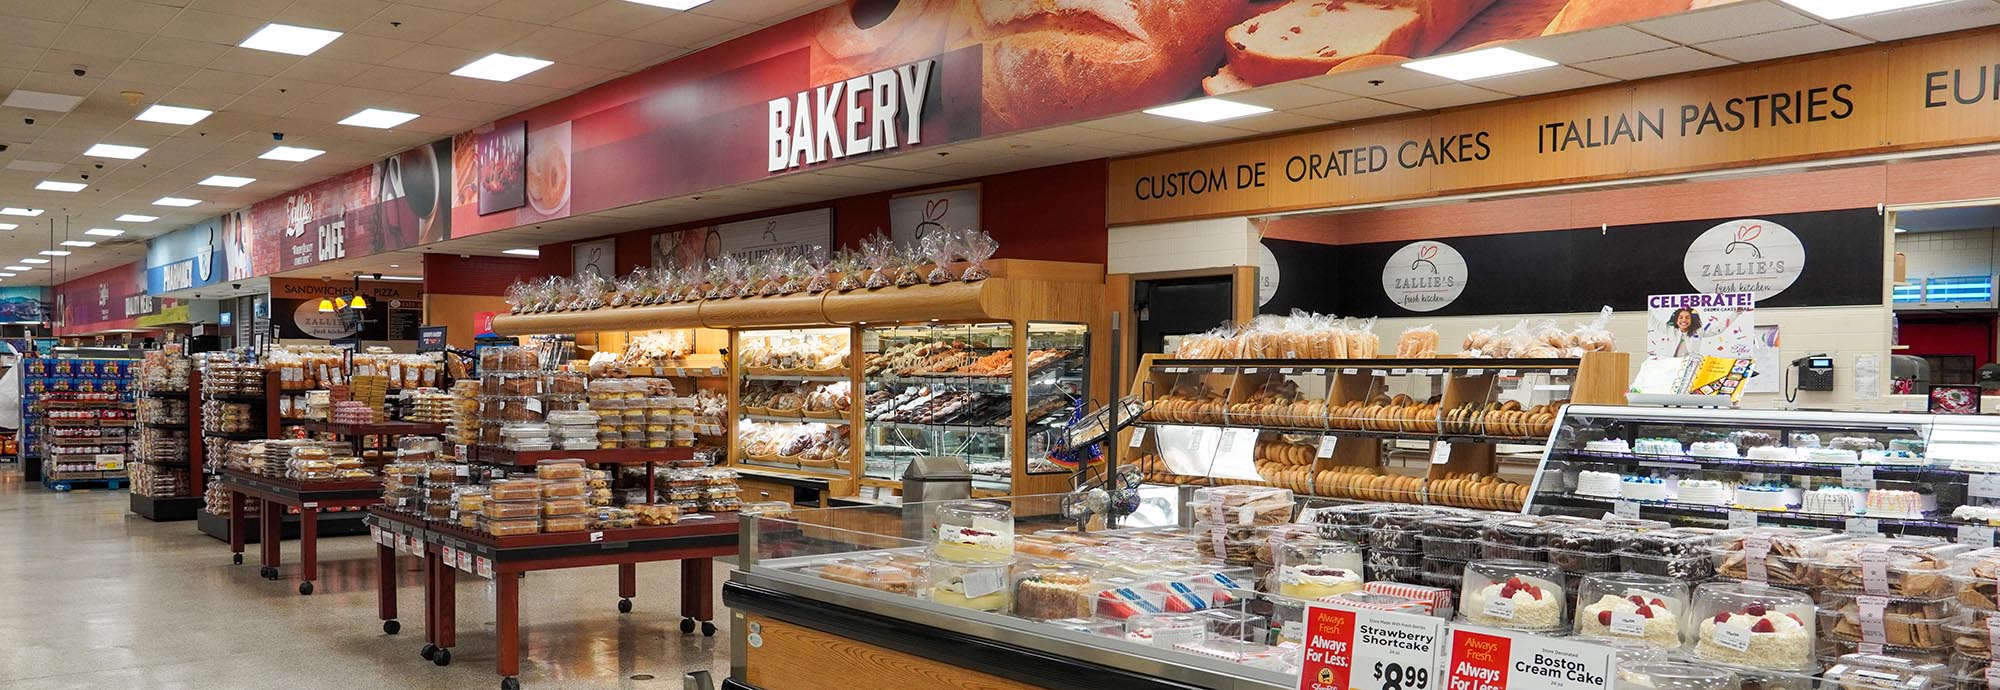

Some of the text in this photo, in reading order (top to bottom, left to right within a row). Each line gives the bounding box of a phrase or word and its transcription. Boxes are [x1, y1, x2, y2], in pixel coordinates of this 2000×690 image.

[768, 59, 935, 172] BAKERY
[1538, 83, 1854, 154] ITALIAN PASTRIES
[1135, 166, 1227, 200] CUSTOM
[1397, 131, 1491, 169] CAKES
[1702, 260, 1785, 277] ZALLIE'S
[284, 284, 354, 296] SANDWICHES
[374, 288, 400, 298] PIZZA
[1395, 275, 1454, 289] ZALLIE'S
[1715, 282, 1771, 293] fresh kitchen
[1649, 293, 1752, 309] CELEBRATE!
[1317, 613, 1344, 625] Always
[1360, 625, 1433, 645] Strawberry
[1362, 634, 1429, 652] Shortcake
[1310, 635, 1347, 654] Always
[1465, 637, 1498, 652] Always
[1306, 649, 1349, 667] For Less.
[1534, 654, 1585, 672] Boston
[1455, 661, 1500, 684] Always
[1515, 661, 1604, 686] Cream Cake
[1450, 675, 1470, 690] For
